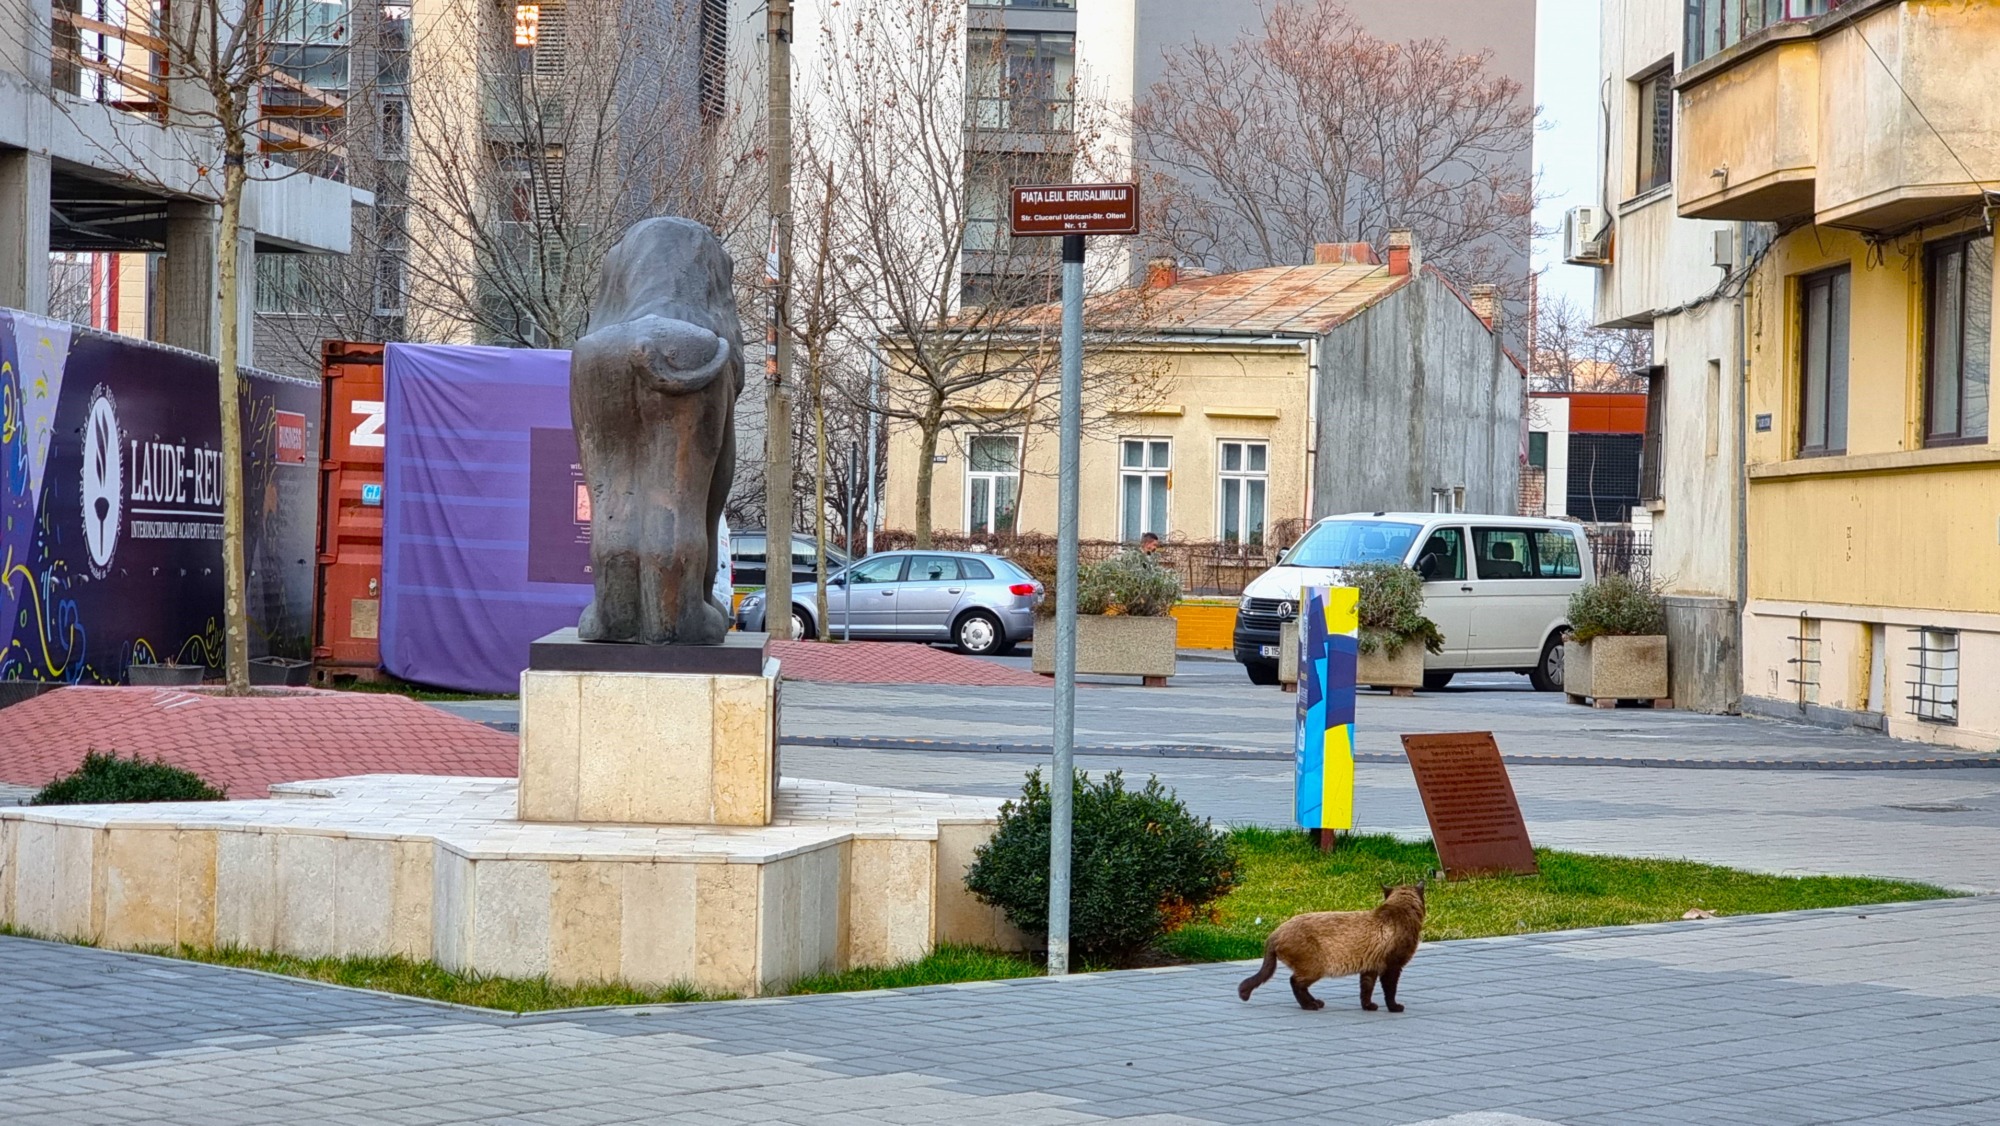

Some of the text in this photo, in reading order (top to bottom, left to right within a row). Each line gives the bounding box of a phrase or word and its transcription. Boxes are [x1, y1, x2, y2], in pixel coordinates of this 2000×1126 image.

[1045, 191, 1064, 202] LEUL
[1066, 189, 1126, 201] IERUSALIMULUI
[131, 440, 223, 506] LAUDE-REU
[131, 520, 179, 538] INTERDISCIPLINARY
[179, 522, 200, 539] ACADEMY
[200, 523, 206, 539] OF
[207, 523, 215, 539] THE
[1264, 646, 1269, 656] B
